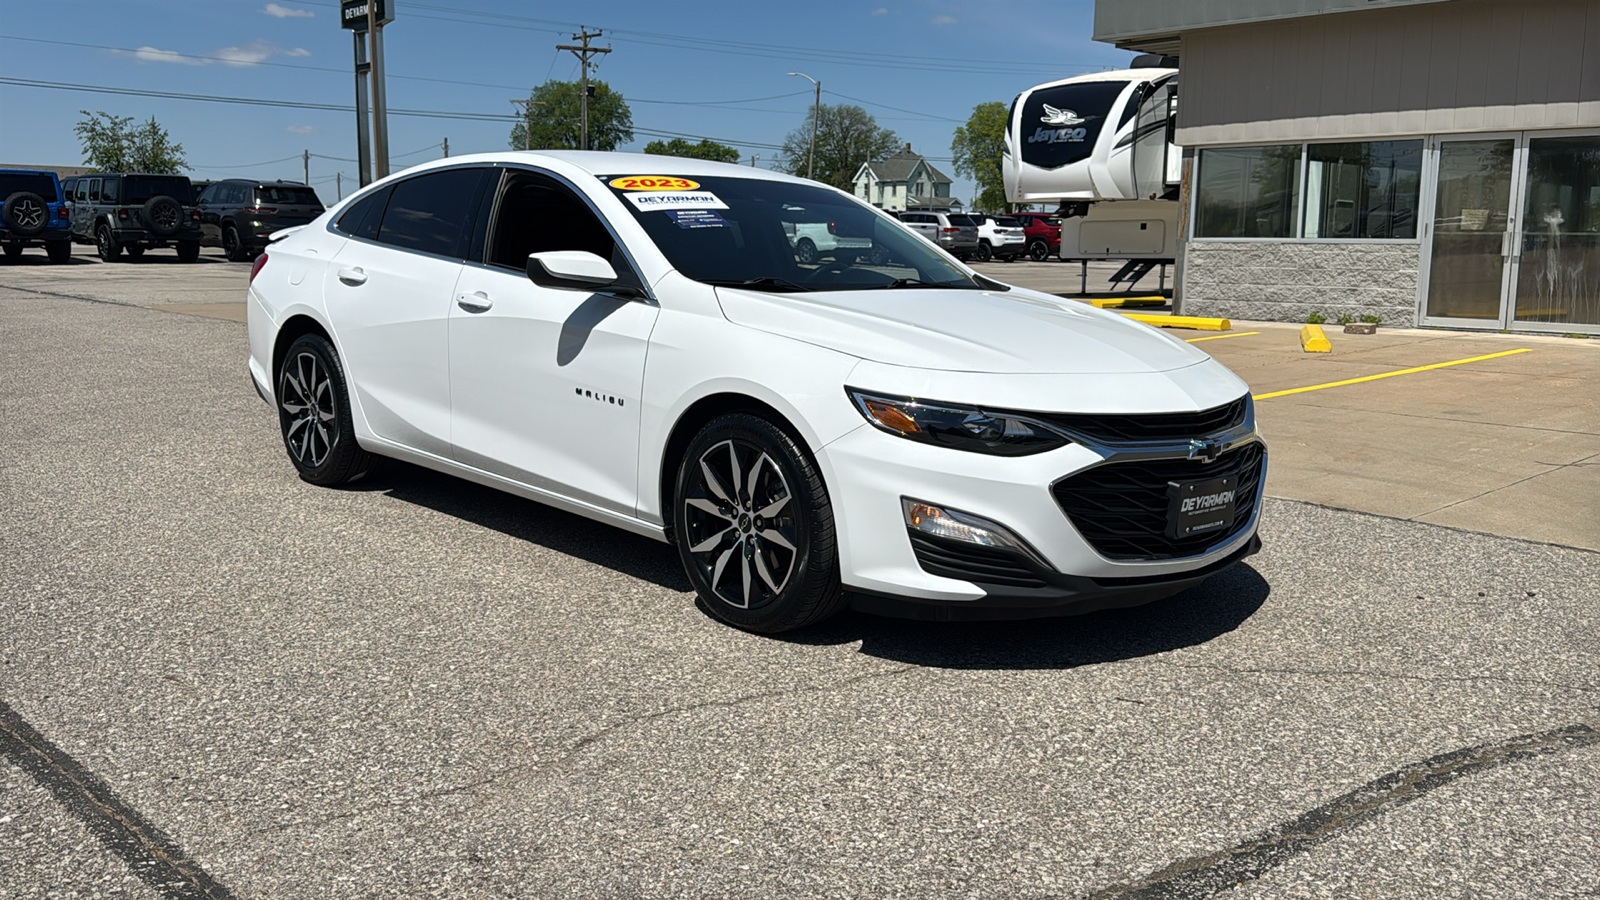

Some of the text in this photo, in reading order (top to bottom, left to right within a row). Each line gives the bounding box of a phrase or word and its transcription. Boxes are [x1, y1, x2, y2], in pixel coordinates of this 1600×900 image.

[345, 2, 377, 19] DEYARMN
[1028, 127, 1087, 144] Jayco
[622, 179, 691, 188] 2023
[638, 195, 715, 203] DEYARMAN
[575, 387, 624, 407] MALIBU
[1181, 490, 1235, 512] DEYARMAN
